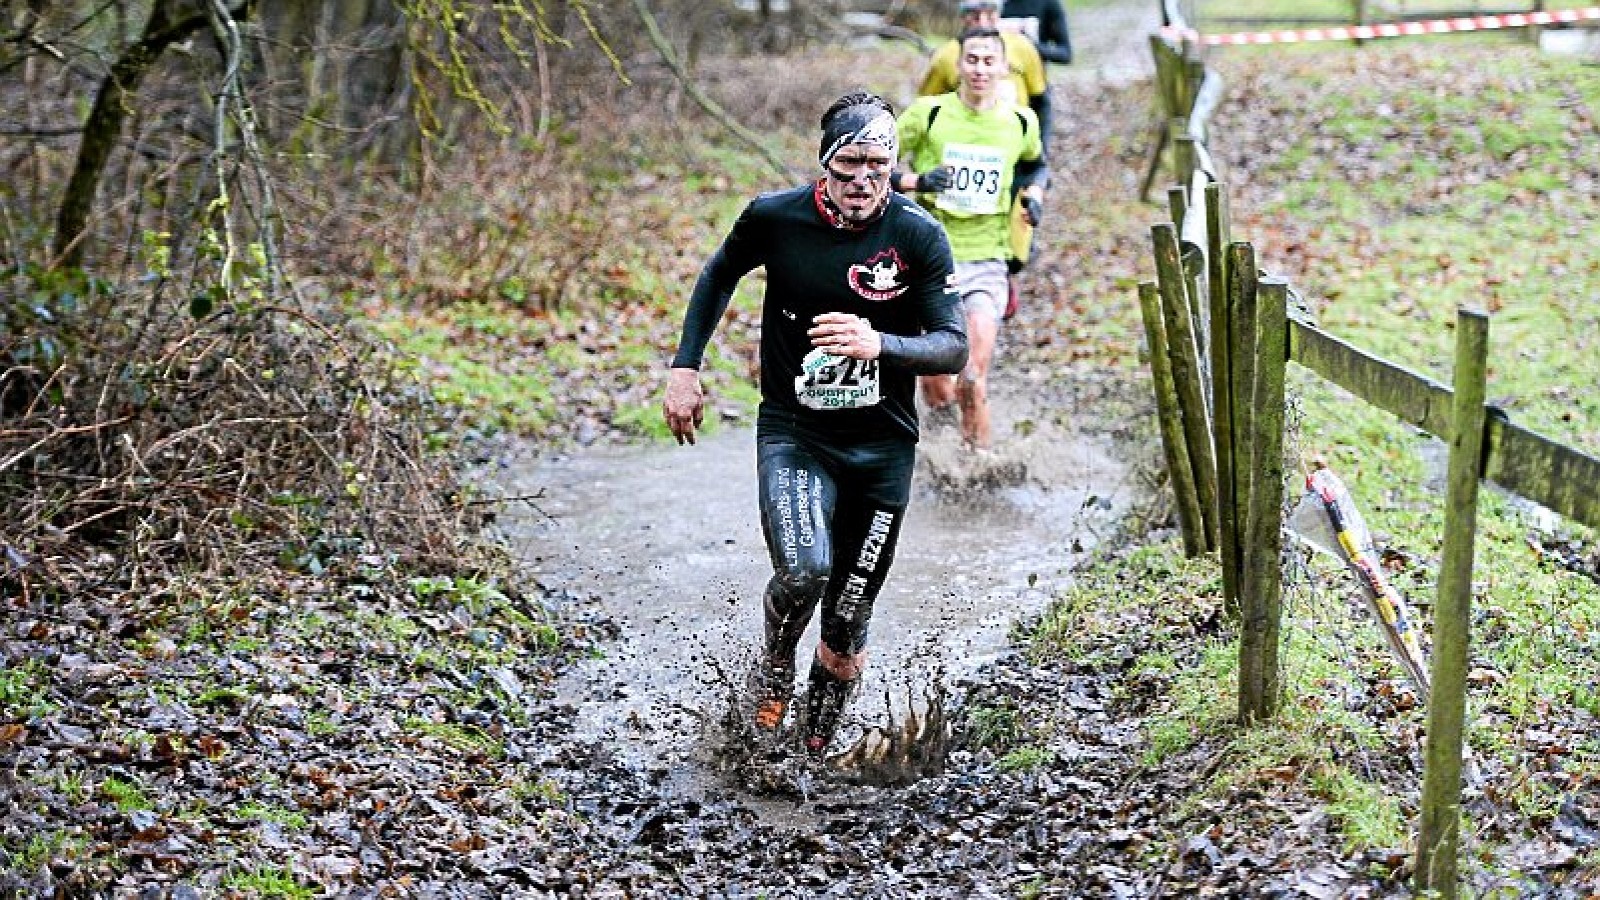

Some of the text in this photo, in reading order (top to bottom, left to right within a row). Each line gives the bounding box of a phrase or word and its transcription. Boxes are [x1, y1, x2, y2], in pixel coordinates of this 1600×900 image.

[850, 385, 876, 398] GUY
[776, 467, 790, 489] und
[857, 510, 894, 572] HARZER
